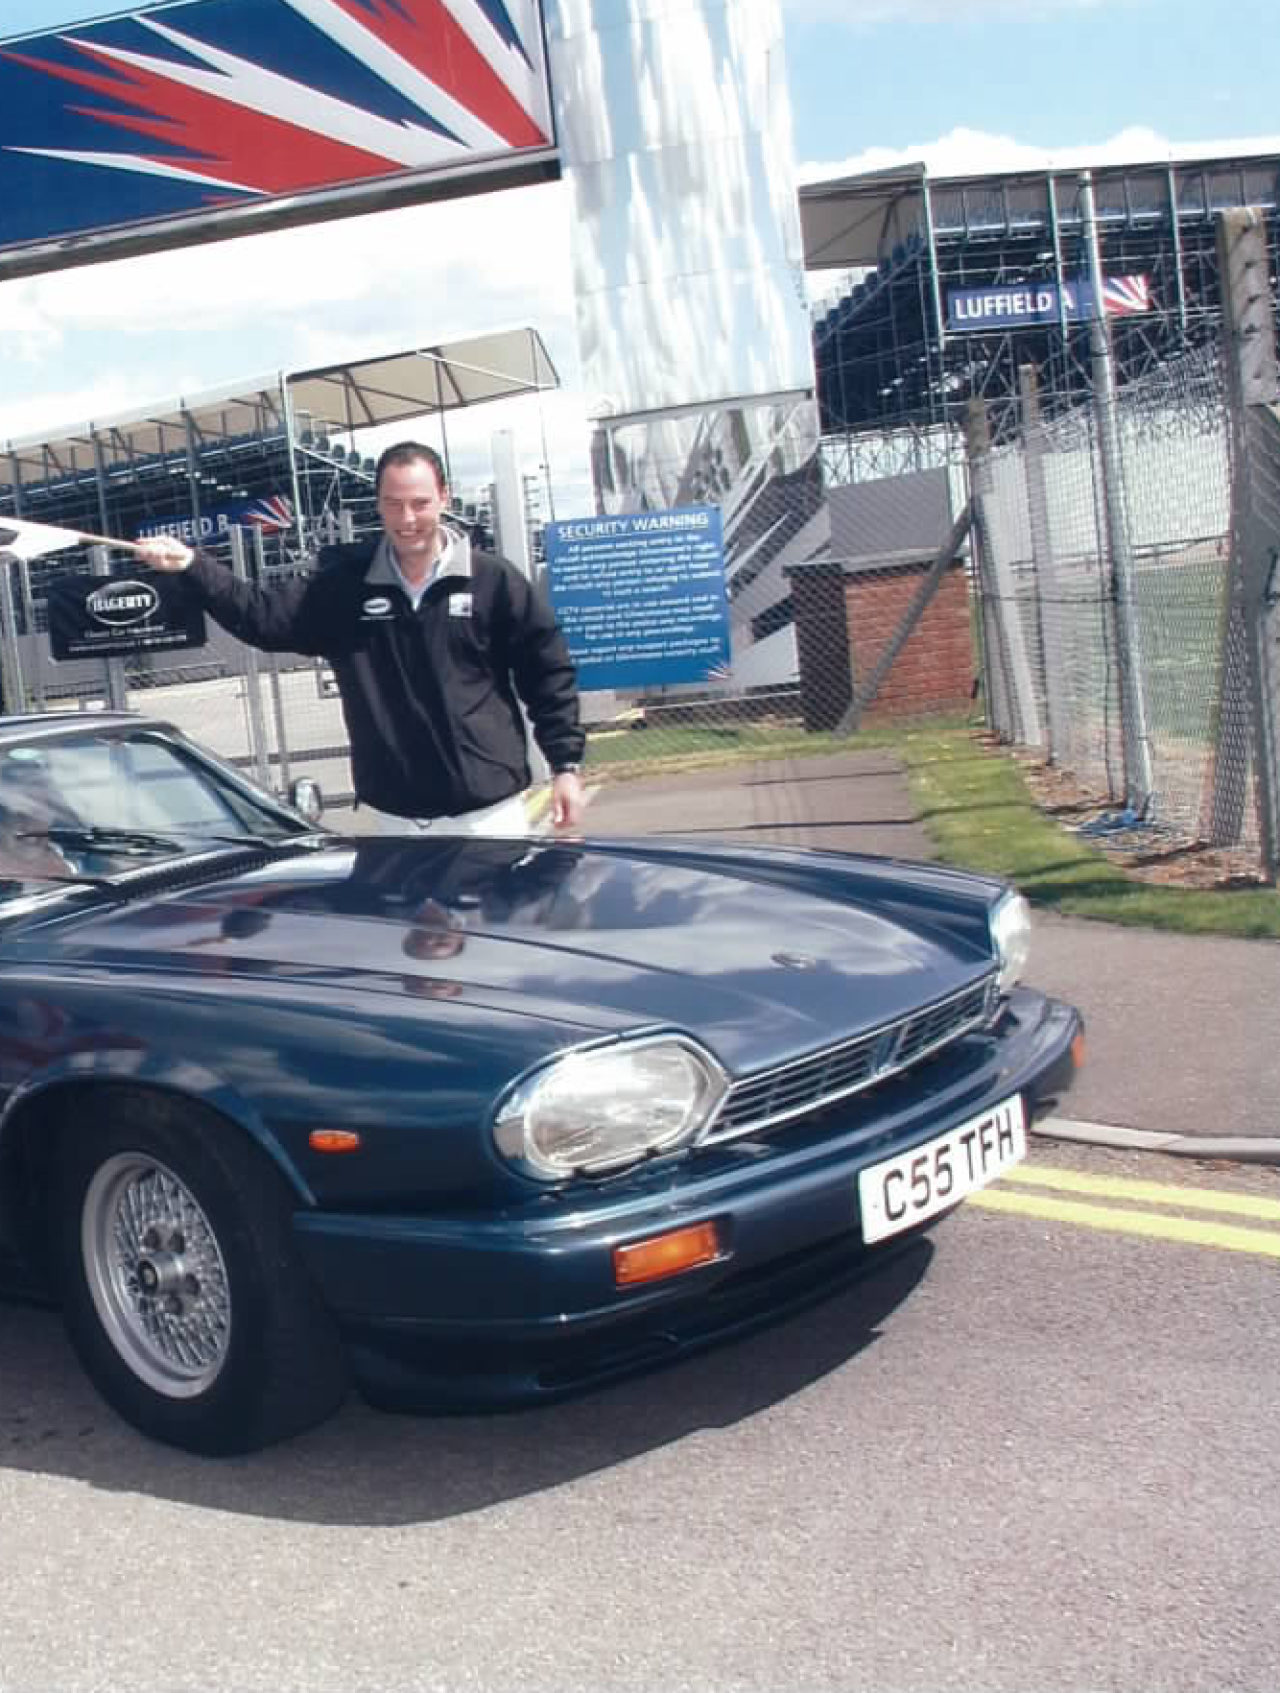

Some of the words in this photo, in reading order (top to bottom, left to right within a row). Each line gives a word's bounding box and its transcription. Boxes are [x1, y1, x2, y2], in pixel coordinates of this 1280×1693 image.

[955, 292, 1052, 319] LUFFIELD
[558, 521, 630, 539] SECURITY
[632, 512, 709, 531] WARNING
[883, 1143, 953, 1221] C55
[959, 1107, 1013, 1181] TFH
